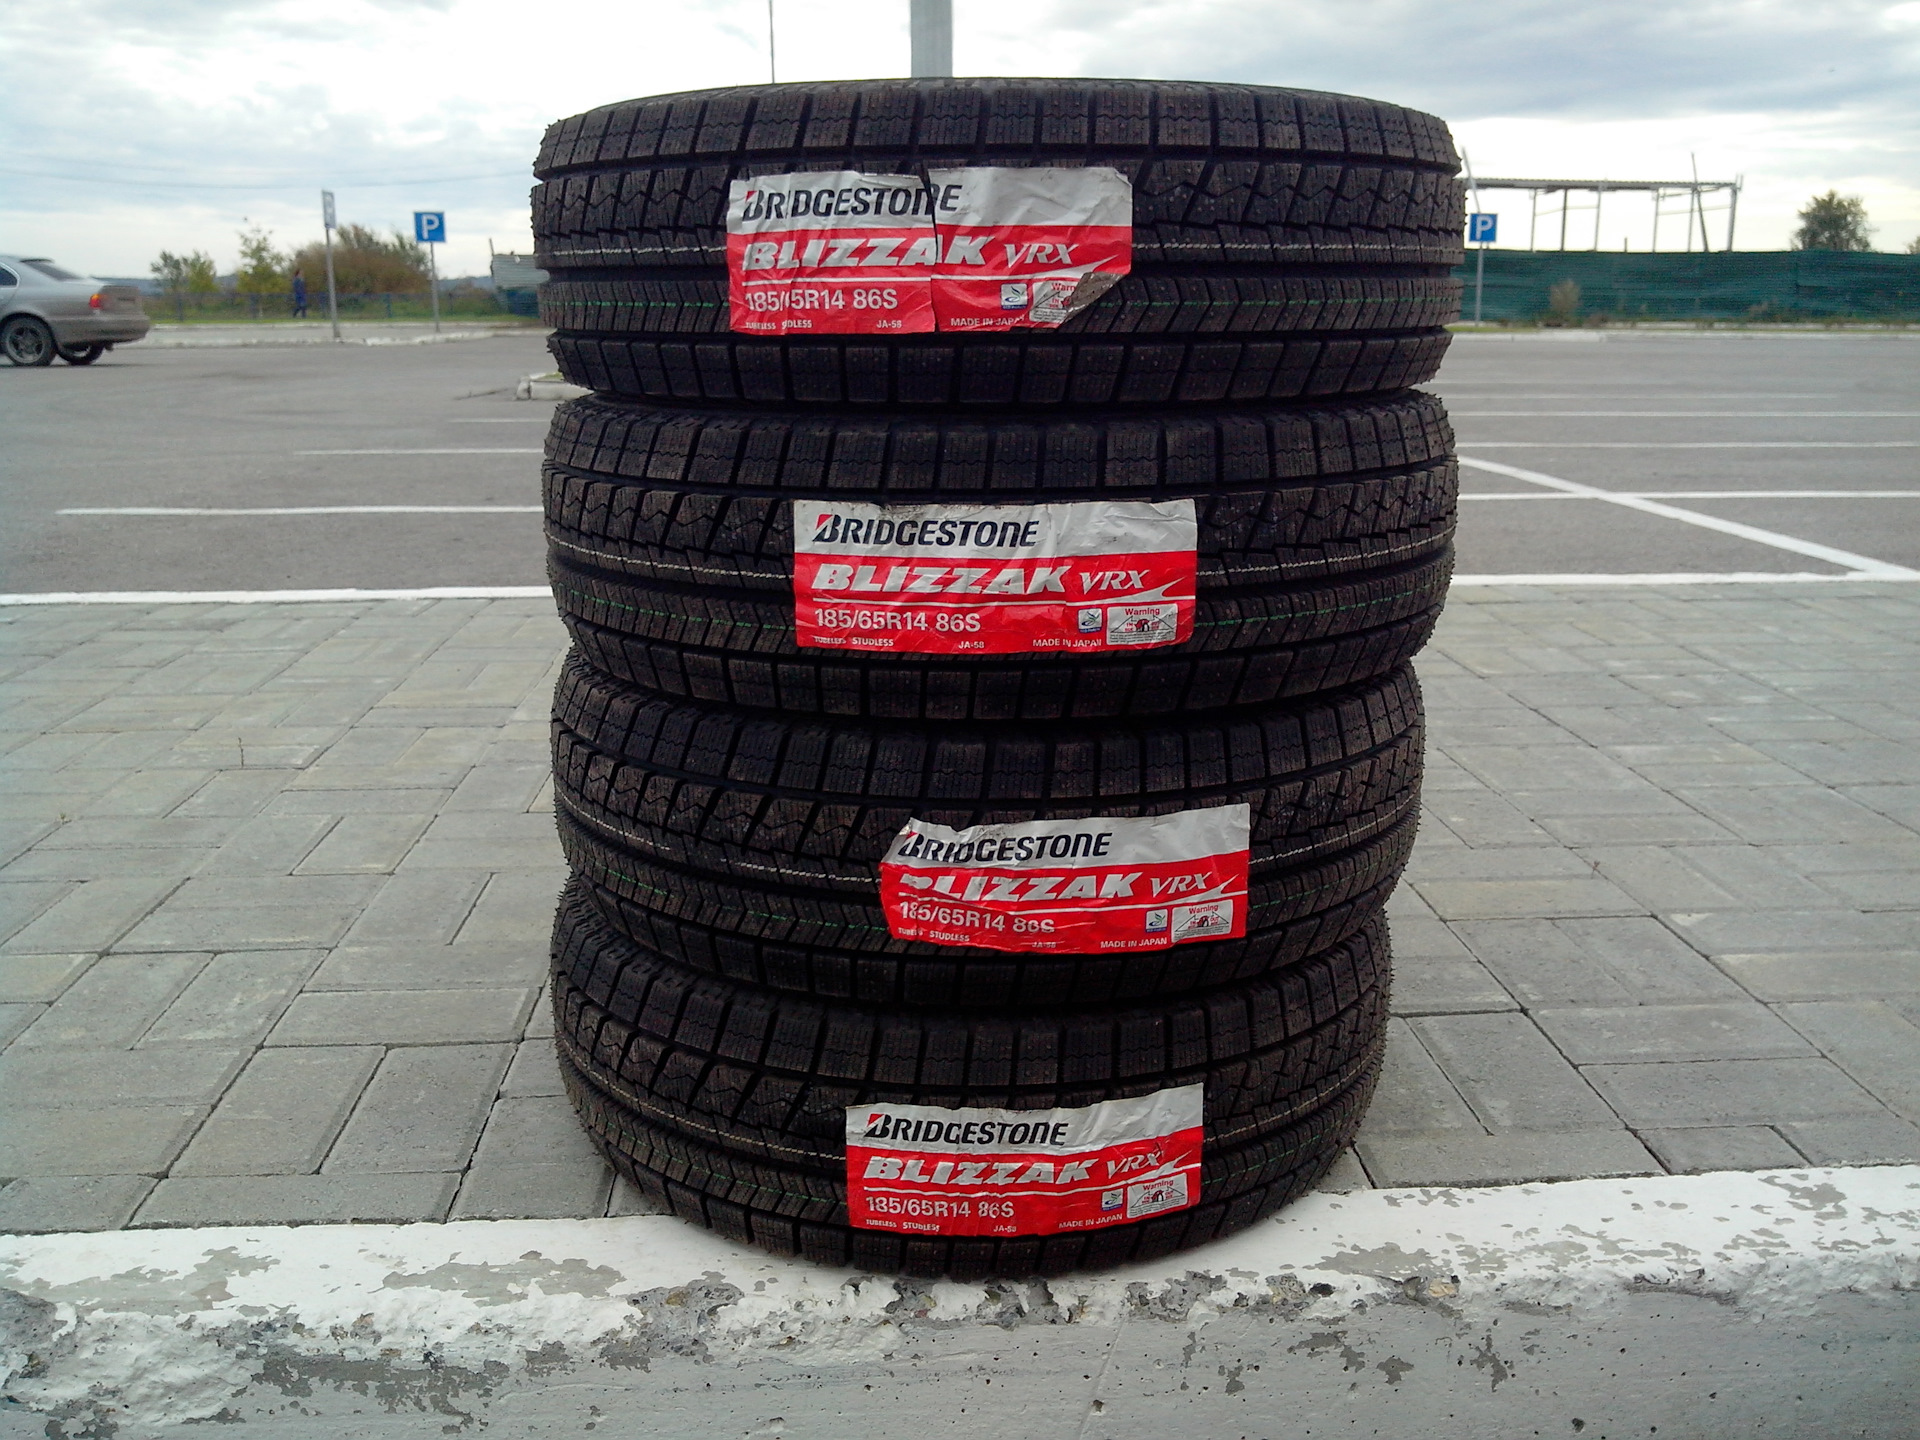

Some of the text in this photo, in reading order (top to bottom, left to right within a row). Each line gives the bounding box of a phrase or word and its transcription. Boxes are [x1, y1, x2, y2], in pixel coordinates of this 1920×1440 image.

[742, 184, 962, 221] BRIDGESTONE
[421, 213, 440, 240] P
[1475, 215, 1494, 240] P
[742, 235, 1079, 271] BLIZZAK VRX
[853, 288, 897, 309] 86S
[876, 320, 902, 328] JA-58
[951, 318, 980, 326] MADE
[983, 318, 993, 326] IN
[812, 514, 1039, 547] BRIDGESTONE
[811, 563, 1150, 595] BLIZZAK VRX
[814, 608, 981, 632] 185/65R14 86S
[1125, 608, 1160, 616] Warning
[852, 637, 894, 646] STUDLESS
[958, 641, 984, 649] JA-58
[1033, 639, 1102, 647] MADE IN JAPAN
[898, 831, 1112, 863] BRIDGESTONE
[1150, 871, 1212, 898] VRX
[1189, 905, 1219, 914] Warning
[929, 932, 970, 942] STUDLESS
[1139, 937, 1167, 946] JAPAN
[864, 1113, 1069, 1145] BRIDGESTONE
[863, 1151, 1163, 1185] BLIZZAK VRX
[1143, 1180, 1174, 1190] Warning
[866, 1196, 1014, 1218] 185/65R14 86S
[866, 1219, 940, 1232] TUBELESS STUDLESS
[1059, 1220, 1083, 1229] MADE
[1096, 1213, 1123, 1224] JAPAN
